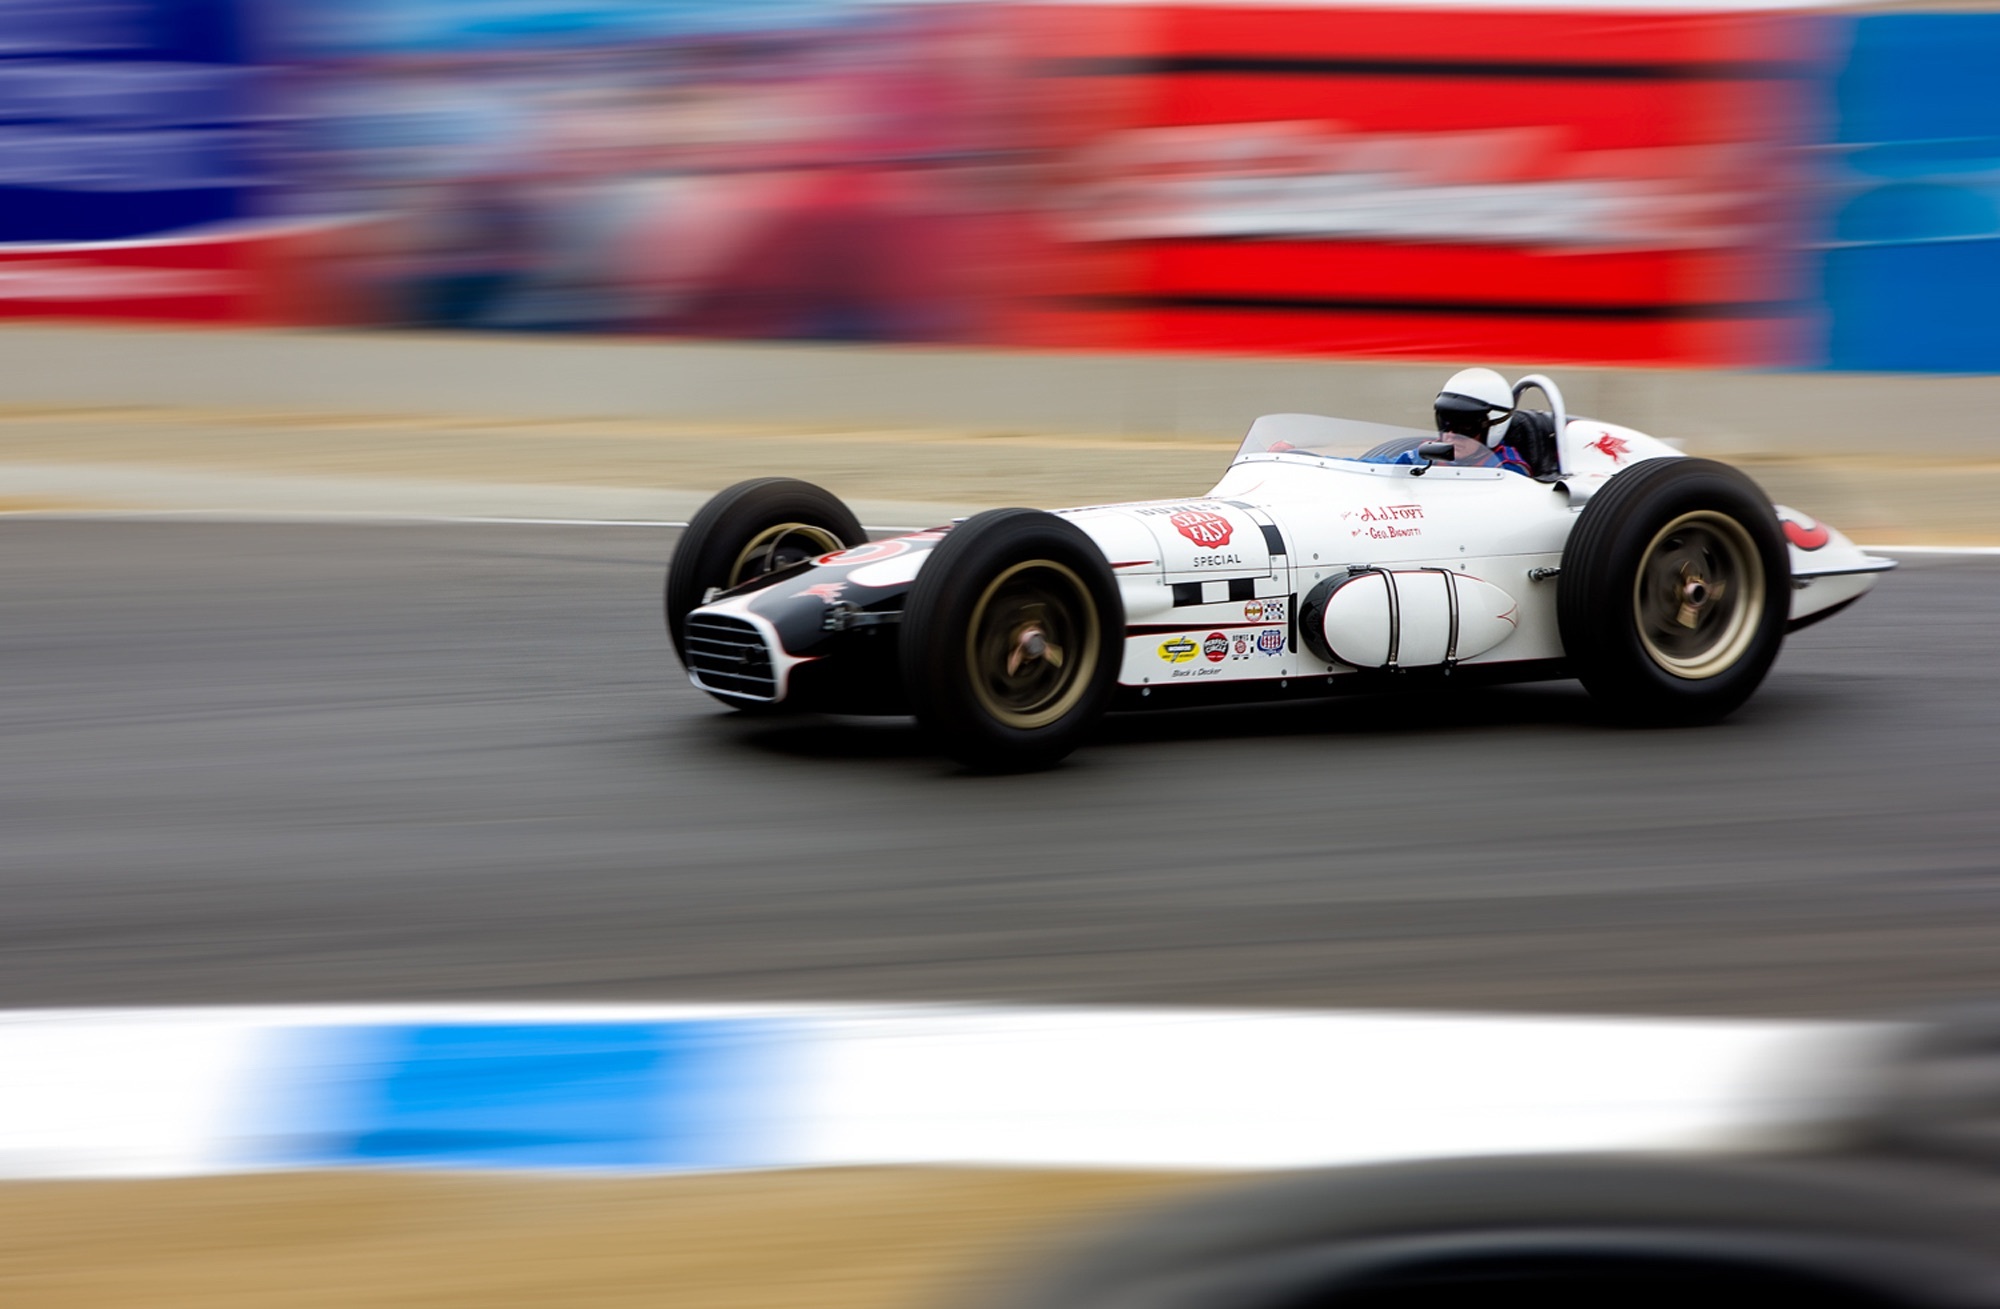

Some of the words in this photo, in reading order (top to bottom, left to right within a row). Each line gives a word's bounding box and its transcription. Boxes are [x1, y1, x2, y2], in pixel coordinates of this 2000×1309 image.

[1174, 510, 1217, 528] SEAL
[1188, 520, 1228, 542] FAST
[1193, 554, 1241, 567] SPECIAL
